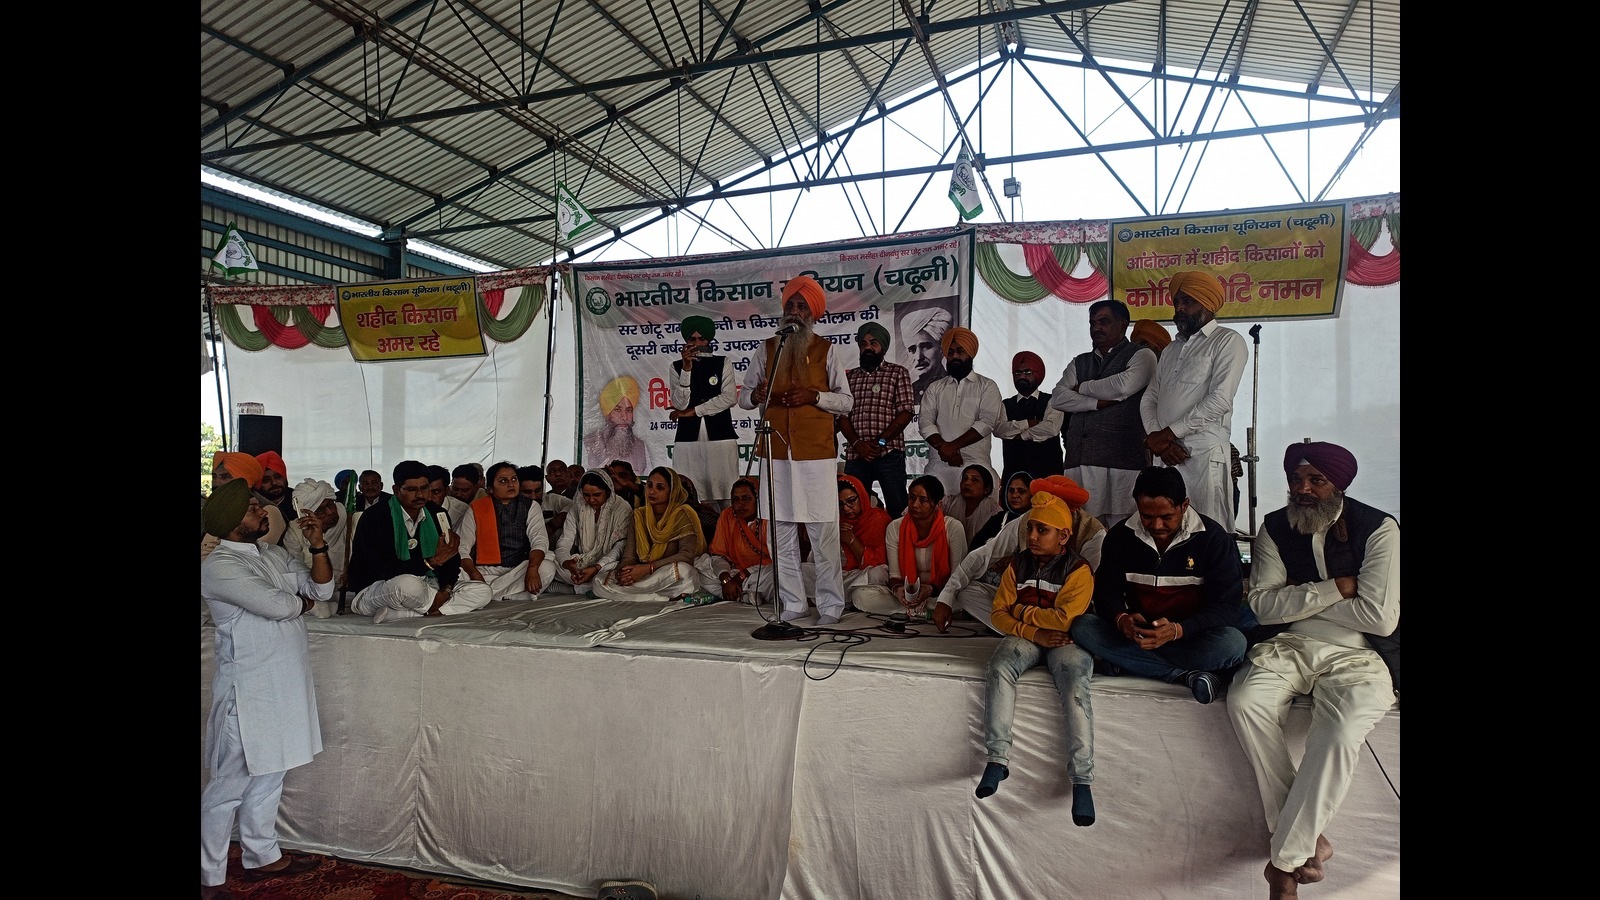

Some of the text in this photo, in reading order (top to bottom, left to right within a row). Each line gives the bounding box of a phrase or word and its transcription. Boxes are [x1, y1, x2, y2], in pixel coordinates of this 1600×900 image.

[1134, 225, 1180, 239] भारतीय
[1184, 222, 1228, 235] किसान
[1232, 218, 1282, 235] यूनियन
[1126, 240, 1326, 270] आंदोलन में शहीद किसानों को
[351, 288, 380, 299] भारतीय
[382, 287, 408, 297] किसान
[412, 286, 440, 298] यूनियन
[614, 282, 690, 307] भारतीय
[696, 279, 774, 303] किसान
[874, 254, 959, 296] (चढूनी)
[1258, 278, 1325, 301] नमन
[356, 302, 458, 328] शहीद किसान
[618, 324, 638, 336] सर
[640, 320, 665, 339] छोटू
[736, 320, 746, 330] व
[858, 304, 880, 320] की
[377, 328, 441, 354] अमर रहे
[626, 341, 656, 360] दूसरी
[650, 421, 658, 430] 24
[740, 416, 752, 428] को
